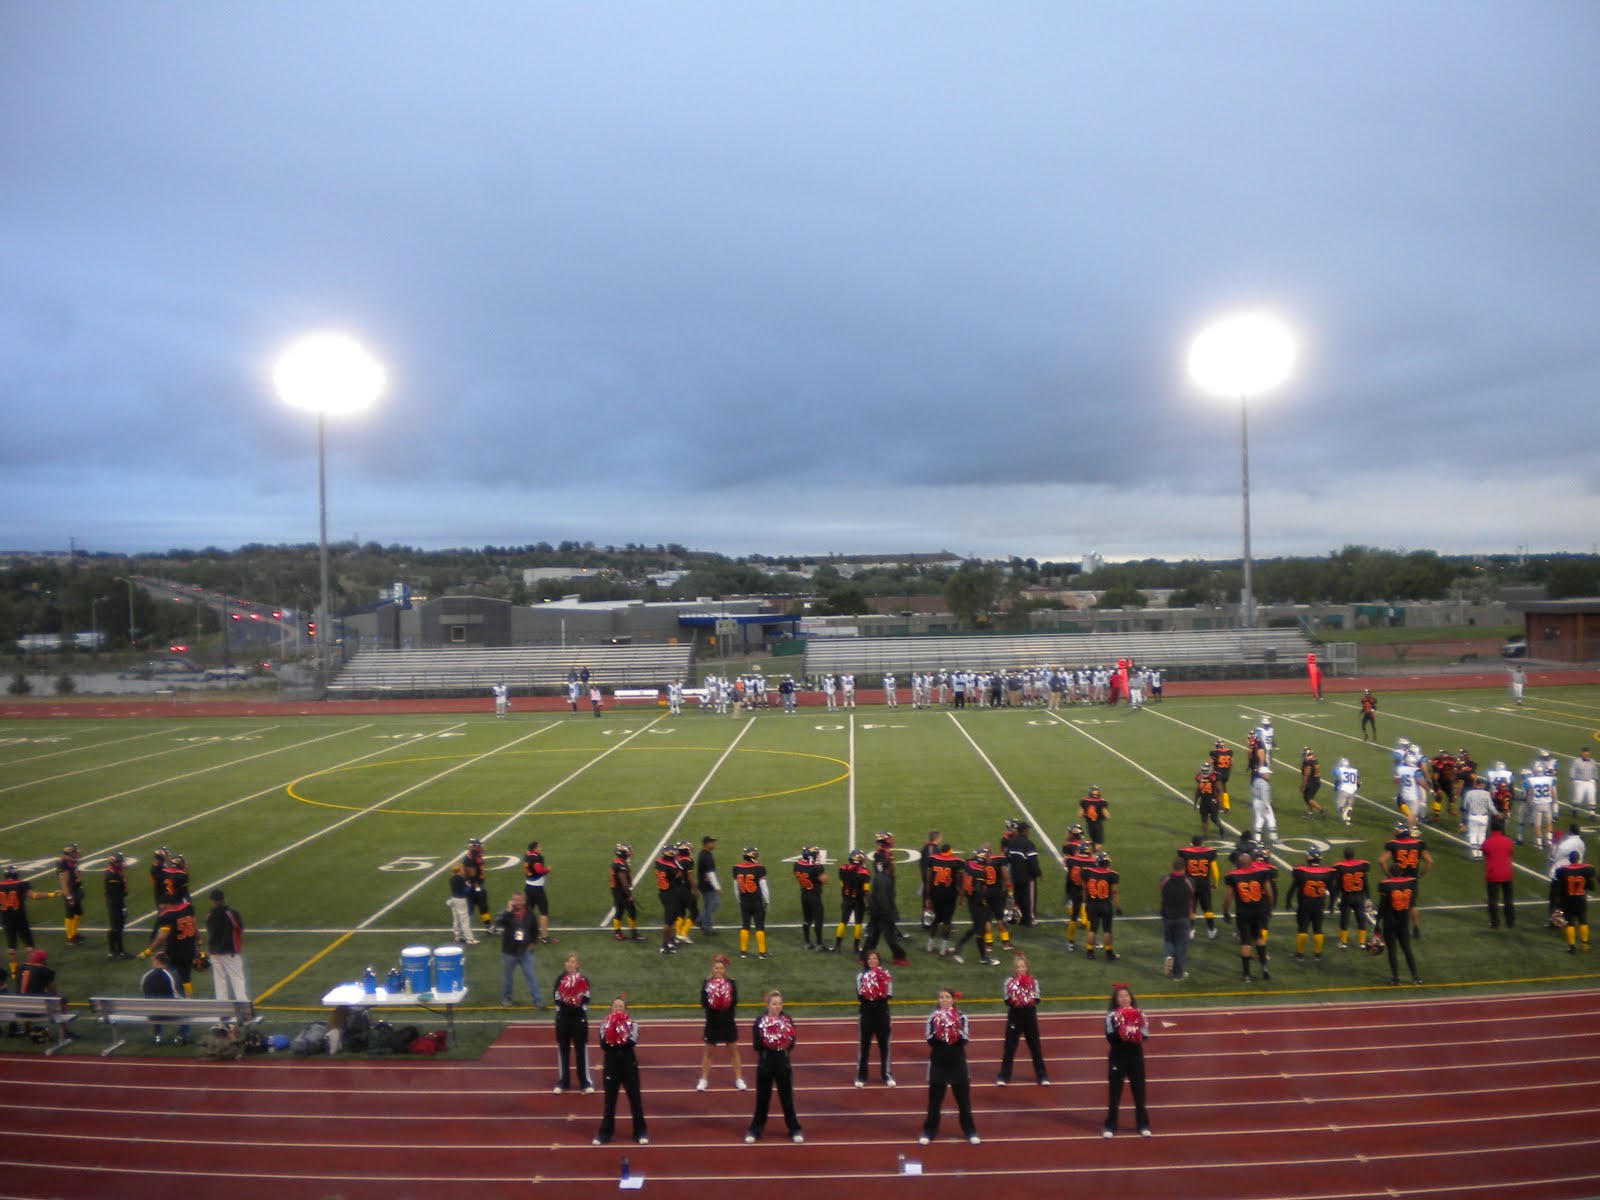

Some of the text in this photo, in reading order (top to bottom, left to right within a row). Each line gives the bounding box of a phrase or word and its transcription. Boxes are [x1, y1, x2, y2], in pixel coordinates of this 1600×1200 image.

[1343, 772, 1356, 784] 30
[1533, 784, 1550, 798] 32
[378, 856, 521, 871] 50
[1397, 849, 1418, 869] 54
[1567, 875, 1585, 895] 12
